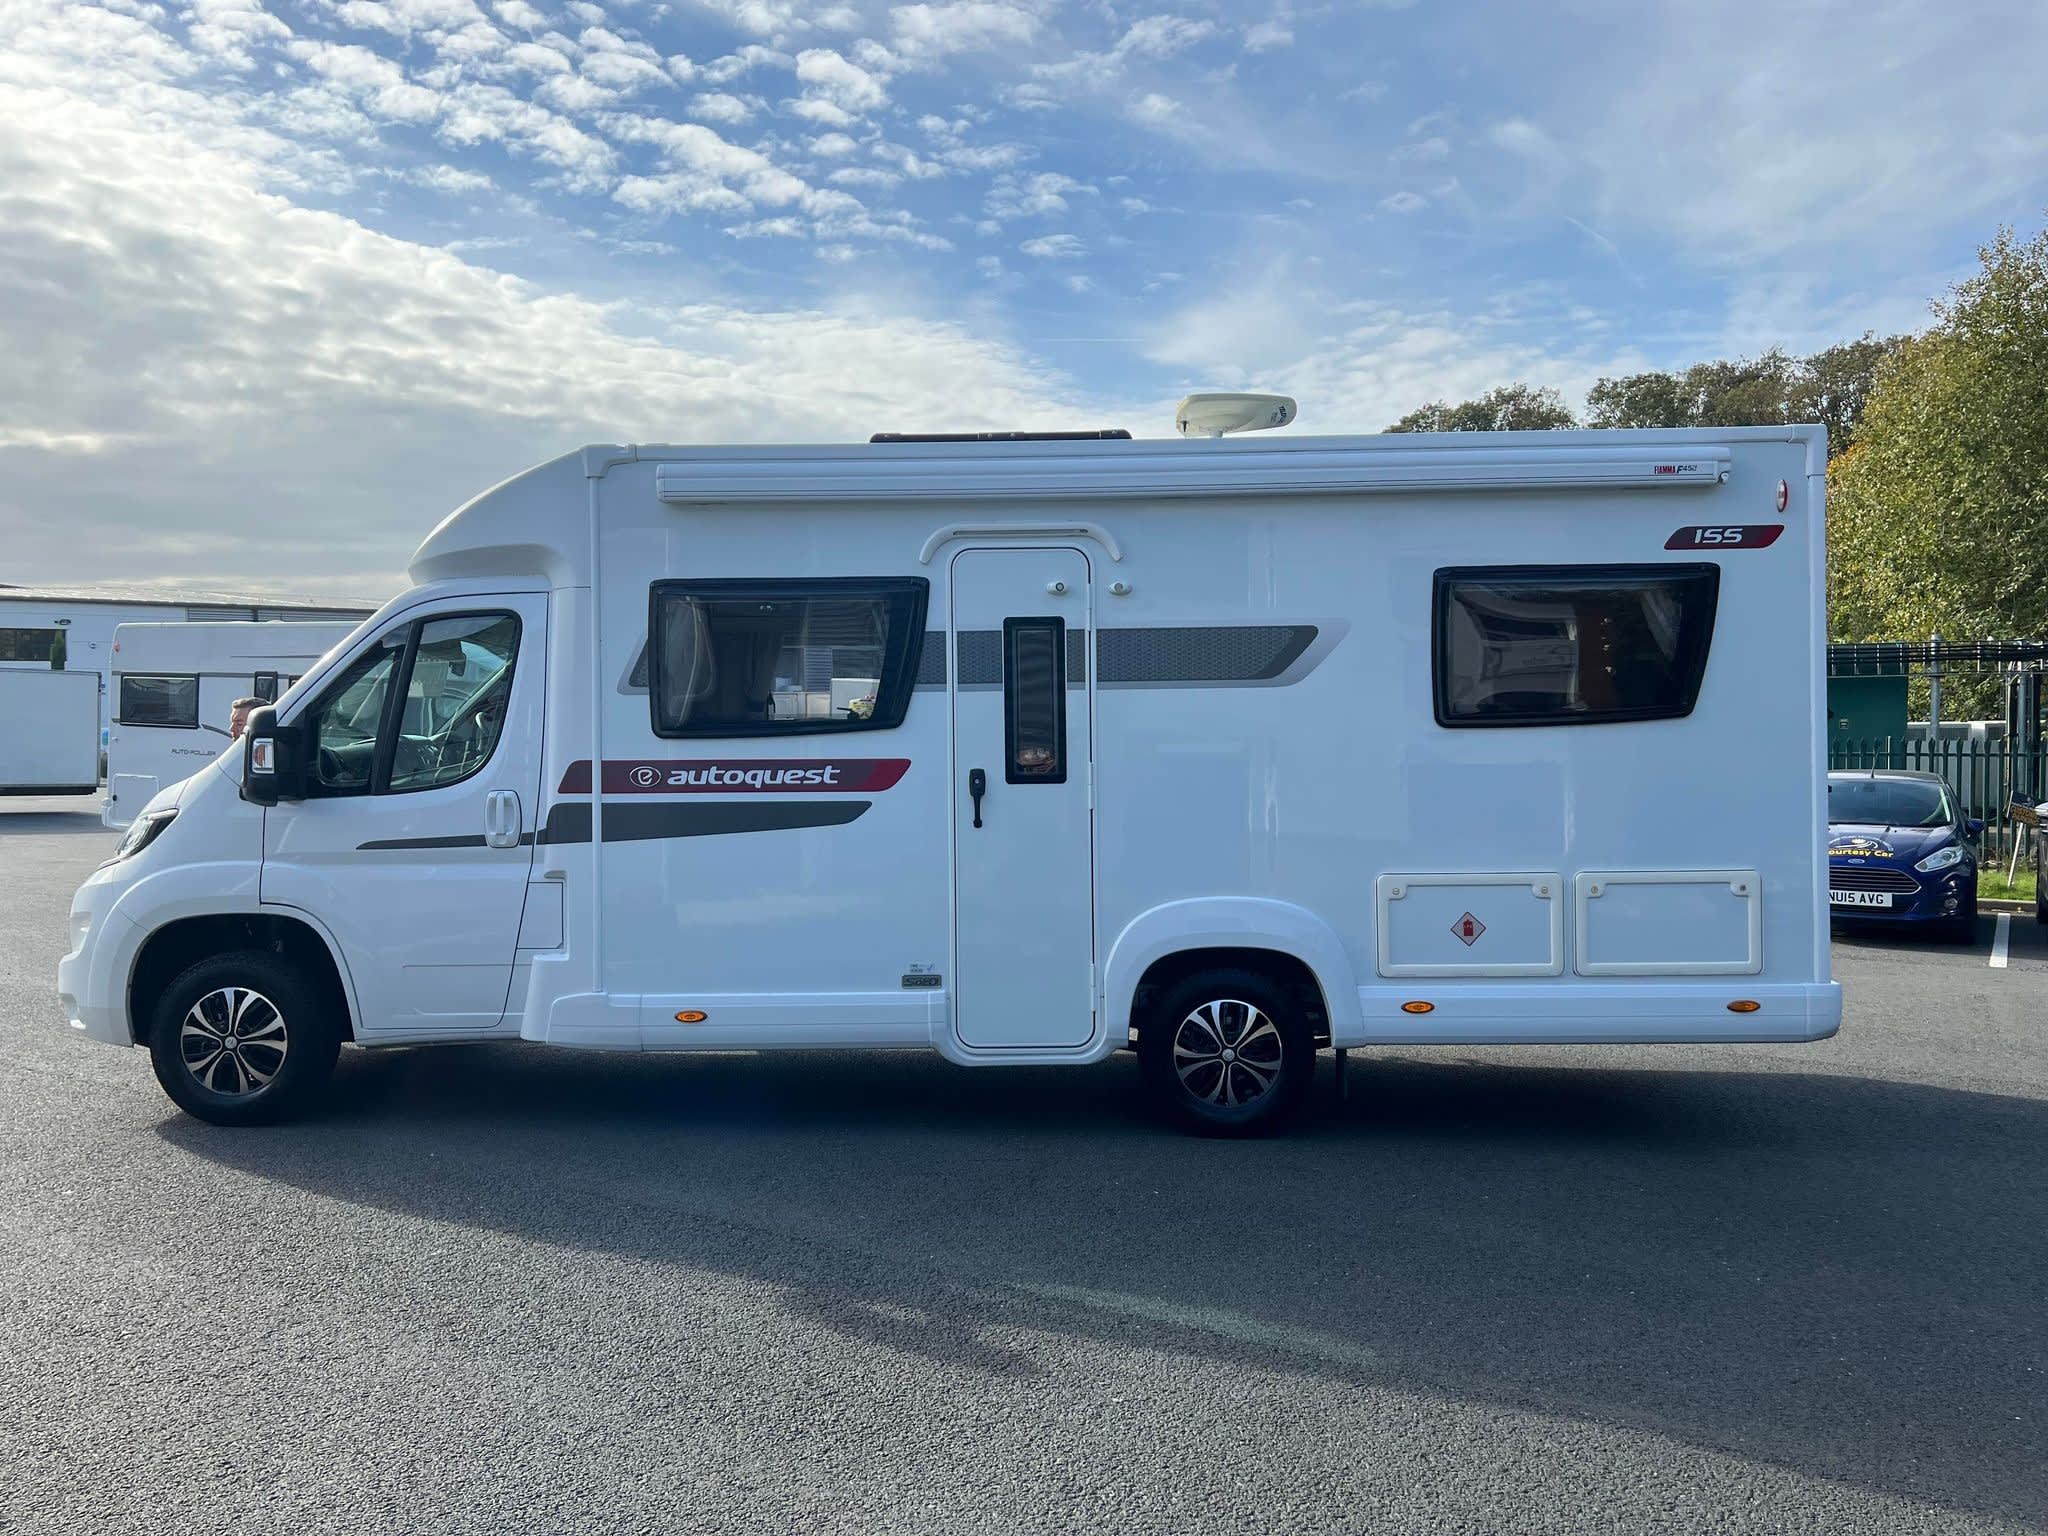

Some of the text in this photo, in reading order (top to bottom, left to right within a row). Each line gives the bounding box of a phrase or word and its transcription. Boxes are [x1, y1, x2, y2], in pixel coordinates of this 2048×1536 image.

[1694, 528, 1744, 544] 155
[667, 765, 841, 789] autoquest
[1828, 849, 1895, 858] ourtesy Car
[1859, 892, 1884, 905] AVG
